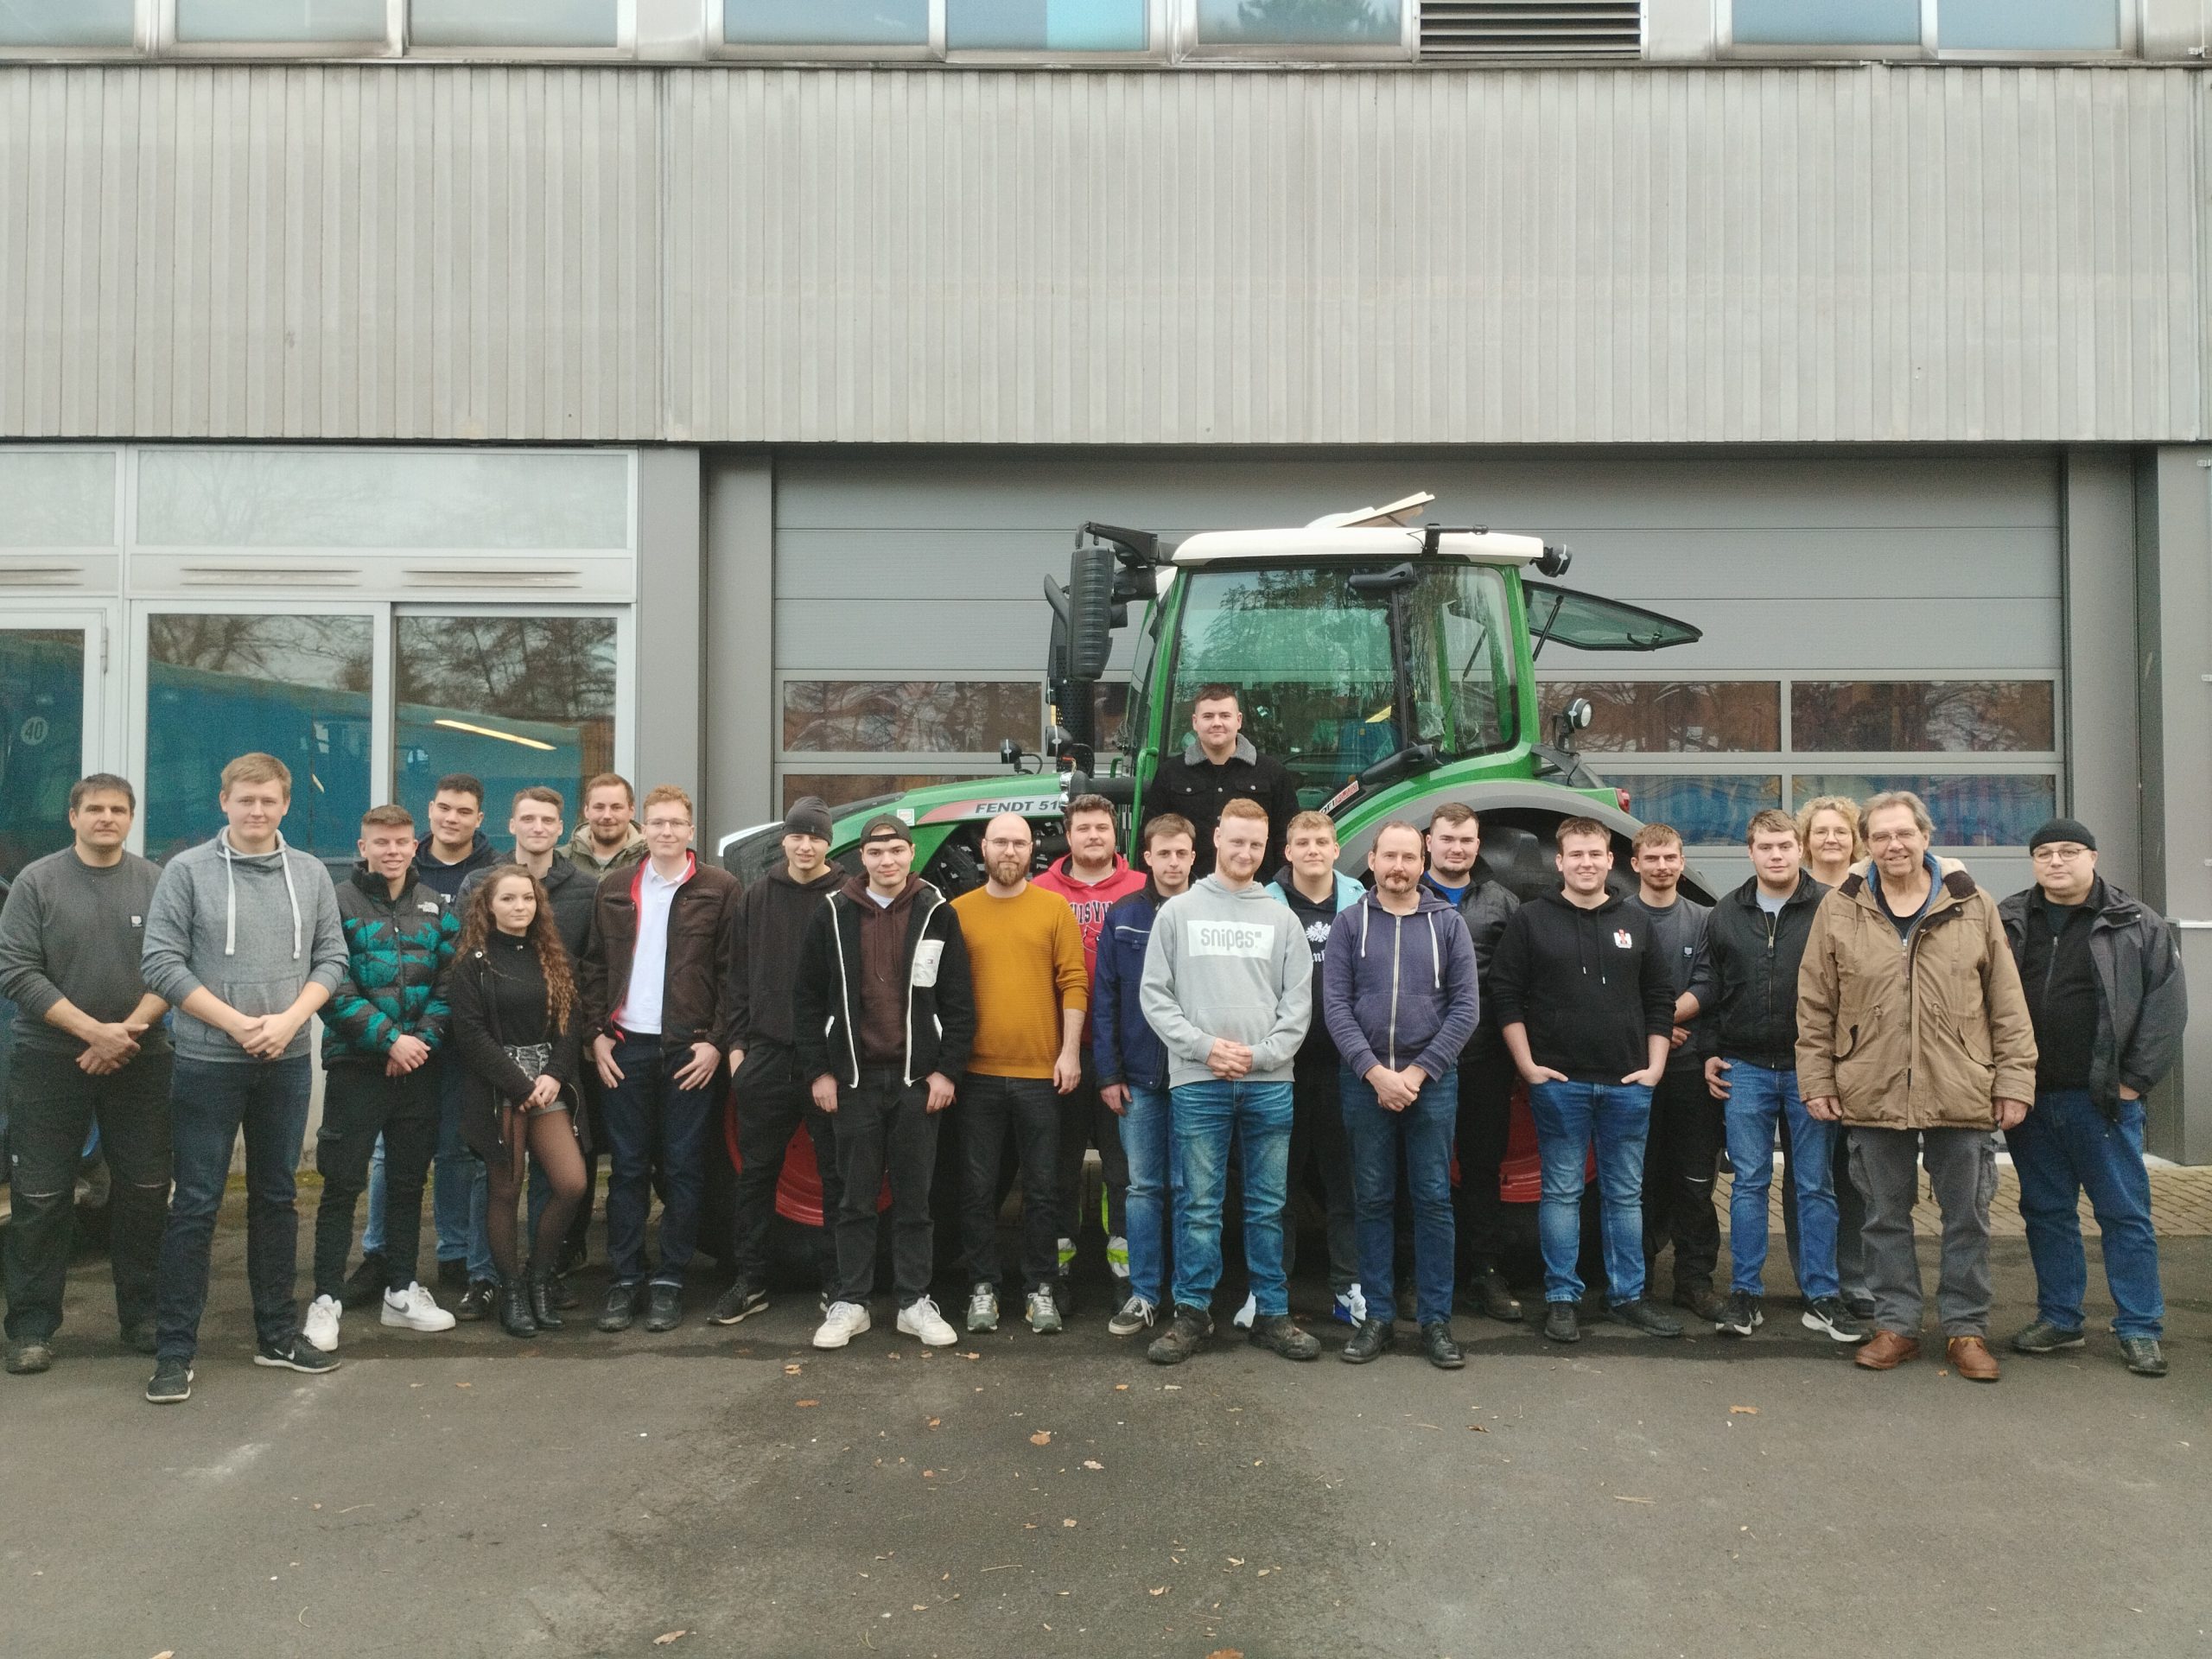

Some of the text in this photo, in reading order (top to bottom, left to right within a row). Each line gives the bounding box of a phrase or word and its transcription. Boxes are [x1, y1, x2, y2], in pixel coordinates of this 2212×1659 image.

[25, 721, 43, 741] 40
[975, 800, 1062, 814] FENDT 51
[1200, 928, 1255, 951] snipes
